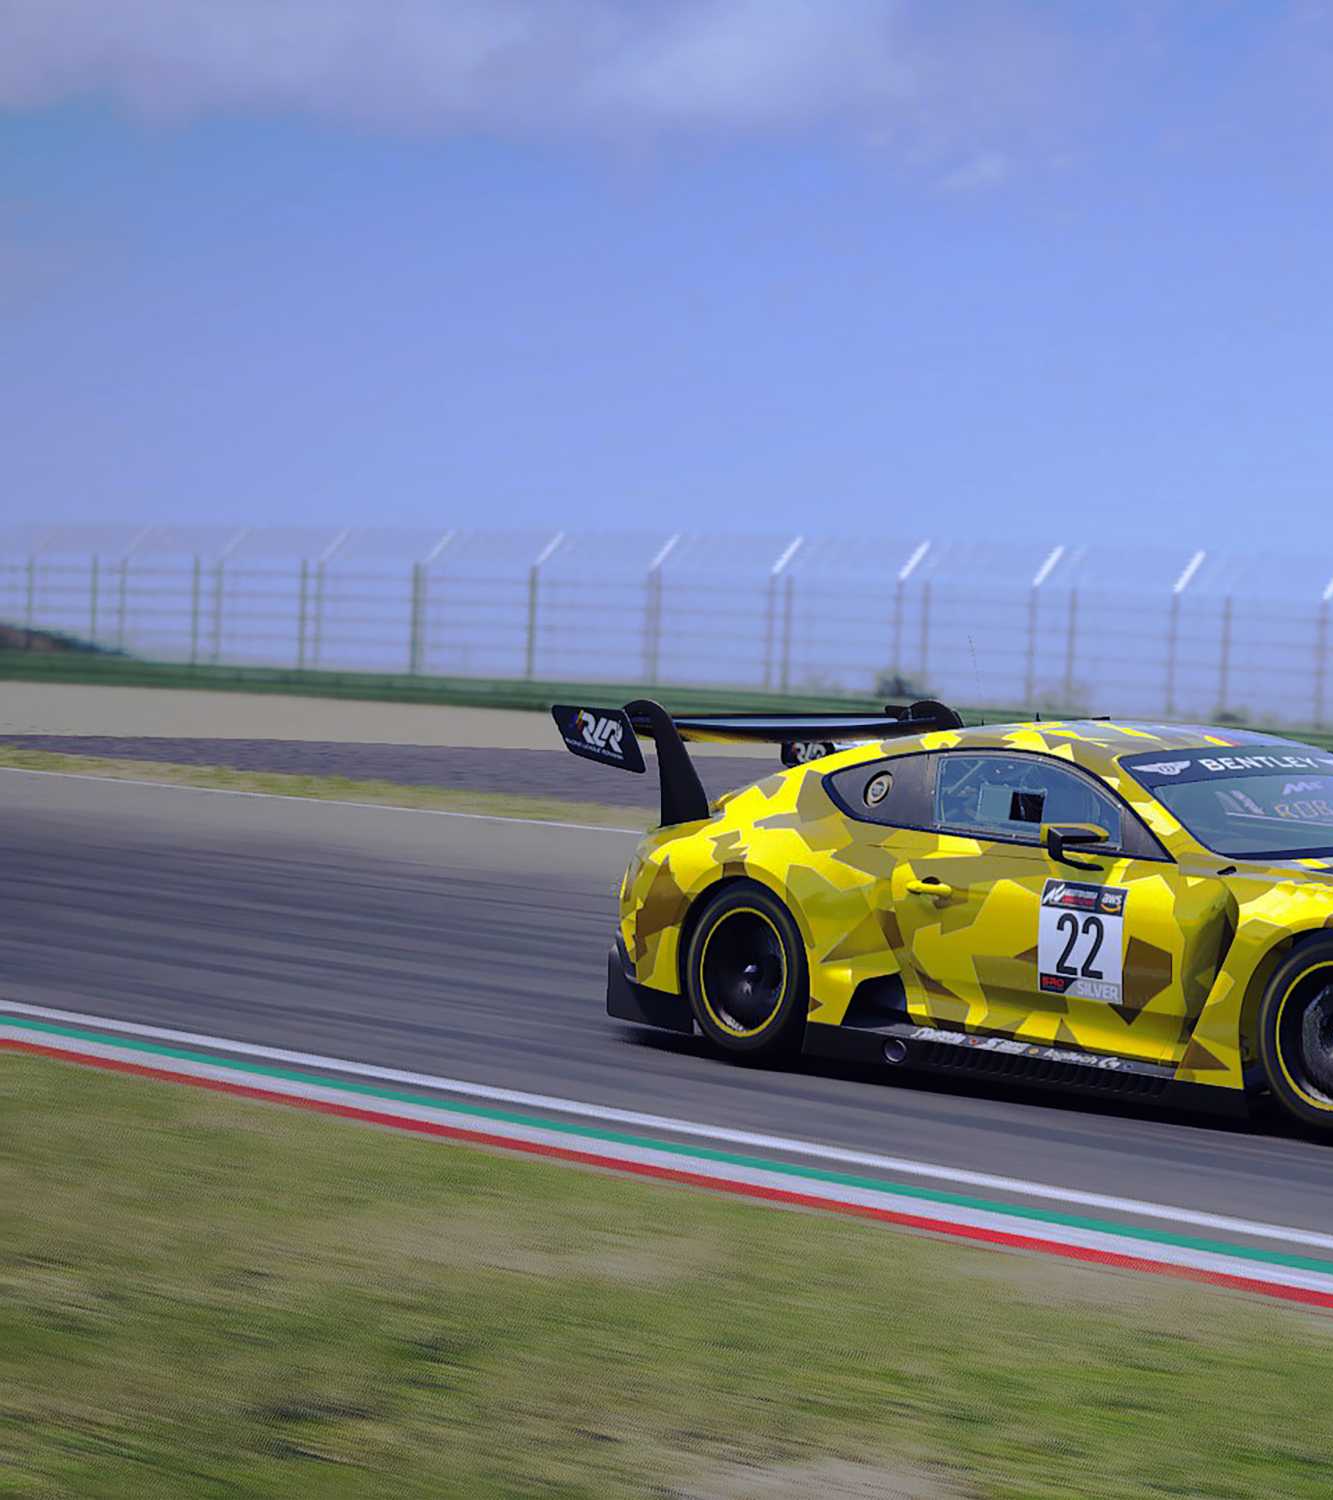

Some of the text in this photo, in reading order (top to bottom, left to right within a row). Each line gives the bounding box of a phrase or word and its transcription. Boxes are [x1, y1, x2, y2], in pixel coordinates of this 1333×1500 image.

[576, 710, 623, 753] RLR
[1198, 756, 1321, 772] BENTLEY
[1056, 912, 1104, 980] 22
[1077, 980, 1119, 1001] SILVER
